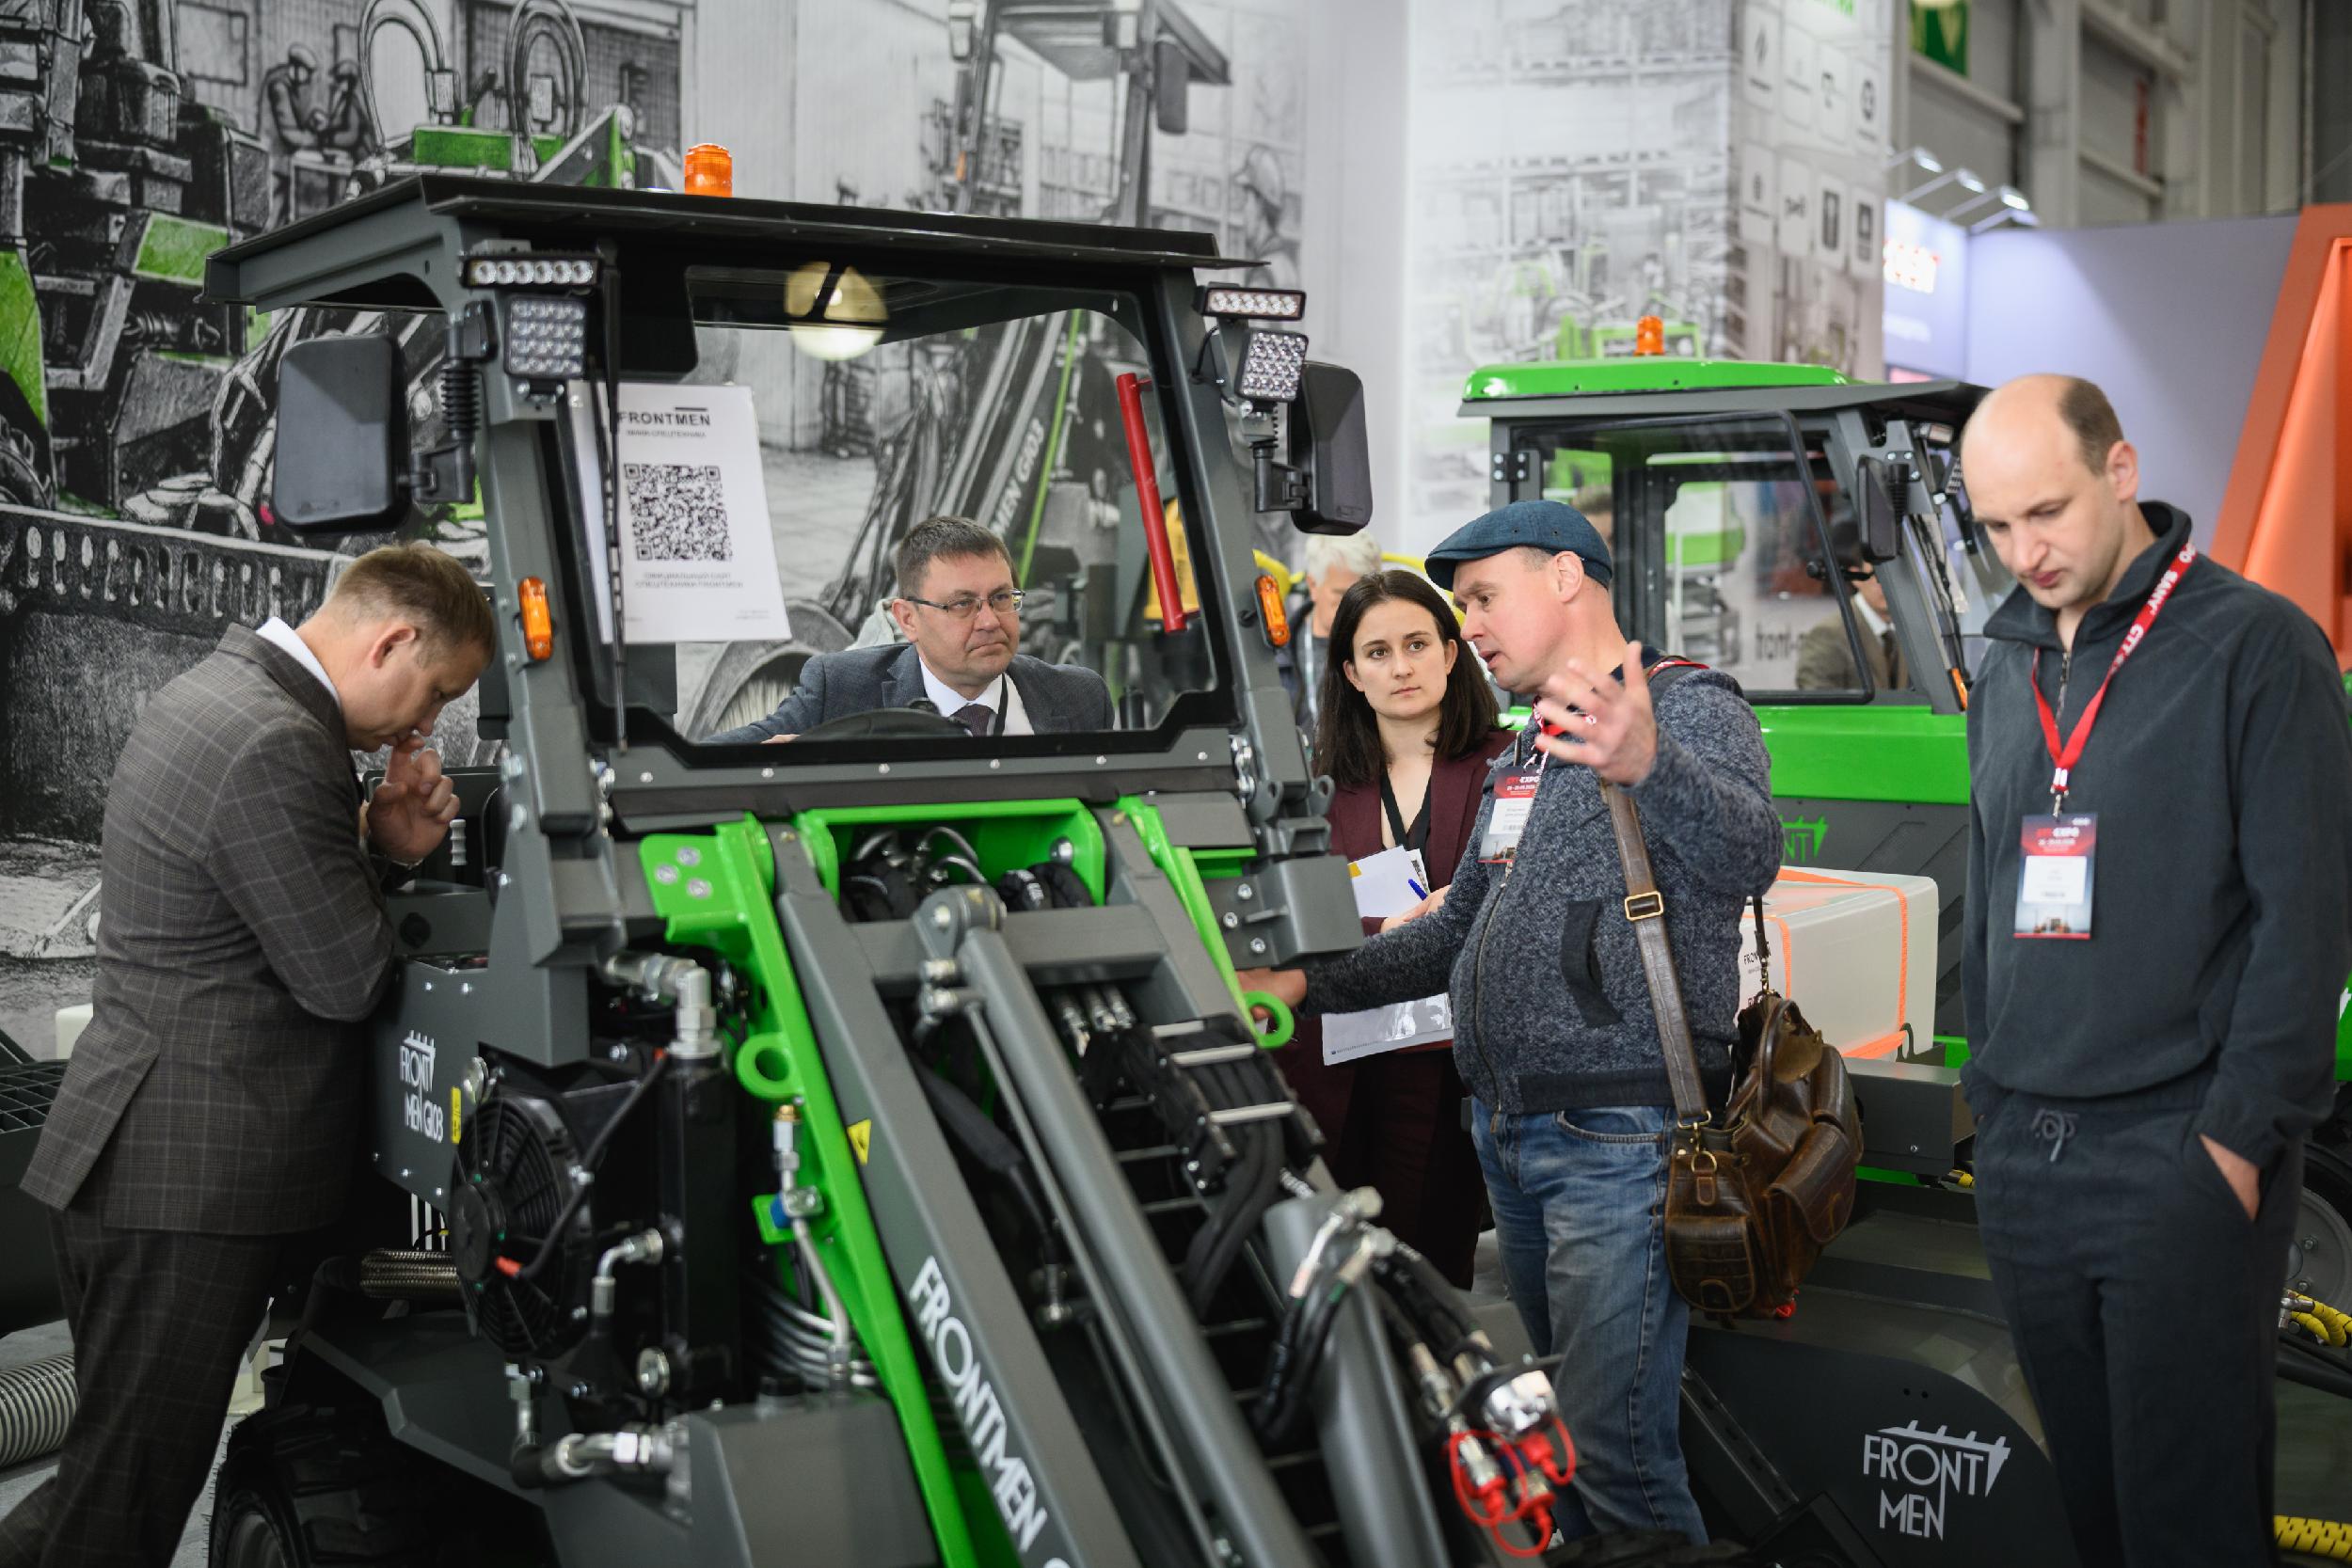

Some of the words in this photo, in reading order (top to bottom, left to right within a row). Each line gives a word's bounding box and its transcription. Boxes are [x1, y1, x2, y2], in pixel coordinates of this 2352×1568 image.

[618, 411, 711, 426] FRONTMEN
[909, 1254, 1048, 1553] FRONTMEN
[1863, 1433, 1985, 1497] FRONT
[1879, 1488, 1947, 1542] MEN
